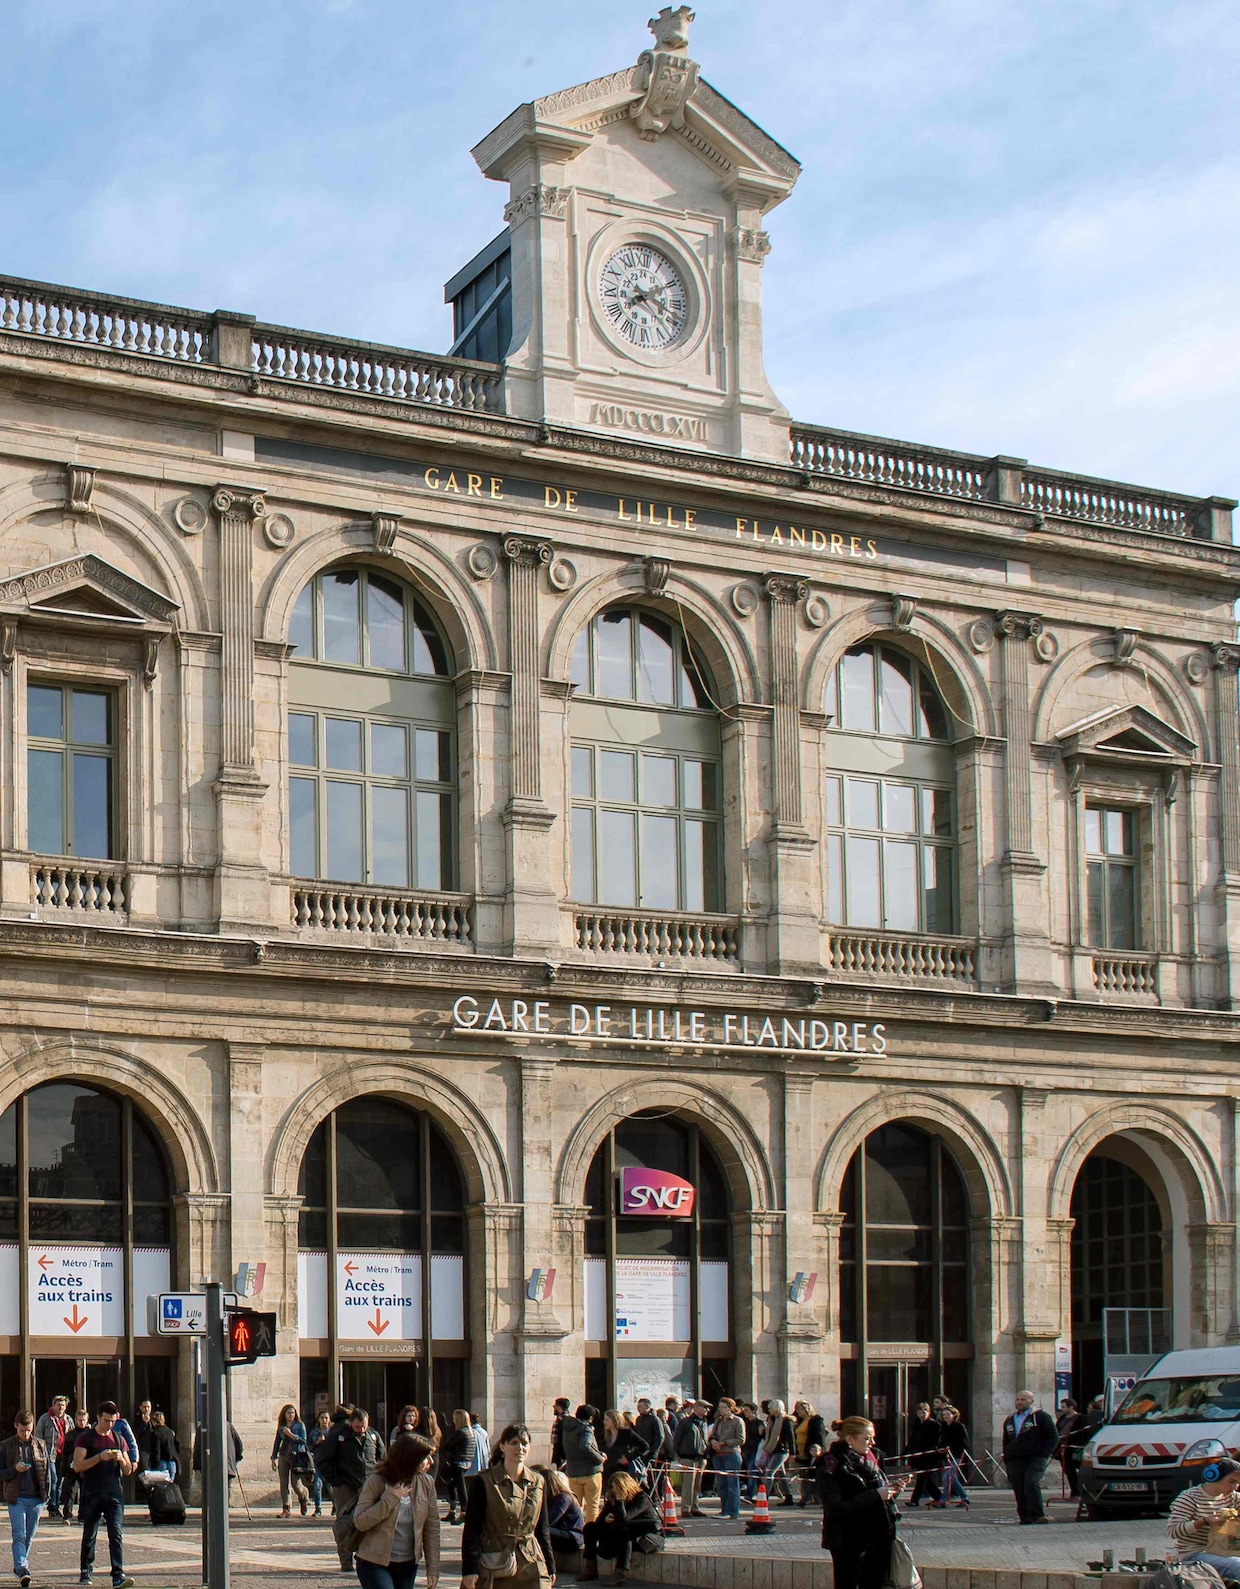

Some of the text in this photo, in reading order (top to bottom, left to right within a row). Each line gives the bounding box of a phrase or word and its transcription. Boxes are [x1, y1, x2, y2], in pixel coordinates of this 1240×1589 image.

[424, 467, 878, 560] GARE DE LILLE FLANDRES
[453, 995, 887, 1053] GARE DE LILLE FLANDRES
[627, 1185, 694, 1209] SNCF
[62, 1259, 87, 1267] Métro
[93, 1260, 113, 1268] Tram
[366, 1266, 389, 1274] Métro
[394, 1266, 412, 1274] Tram
[38, 1272, 83, 1287] Accès
[344, 1278, 385, 1291] Accès
[37, 1289, 113, 1302] aux trains
[344, 1294, 412, 1307] aux trains
[186, 1309, 202, 1318] Lille
[366, 1345, 383, 1353] LILLE
